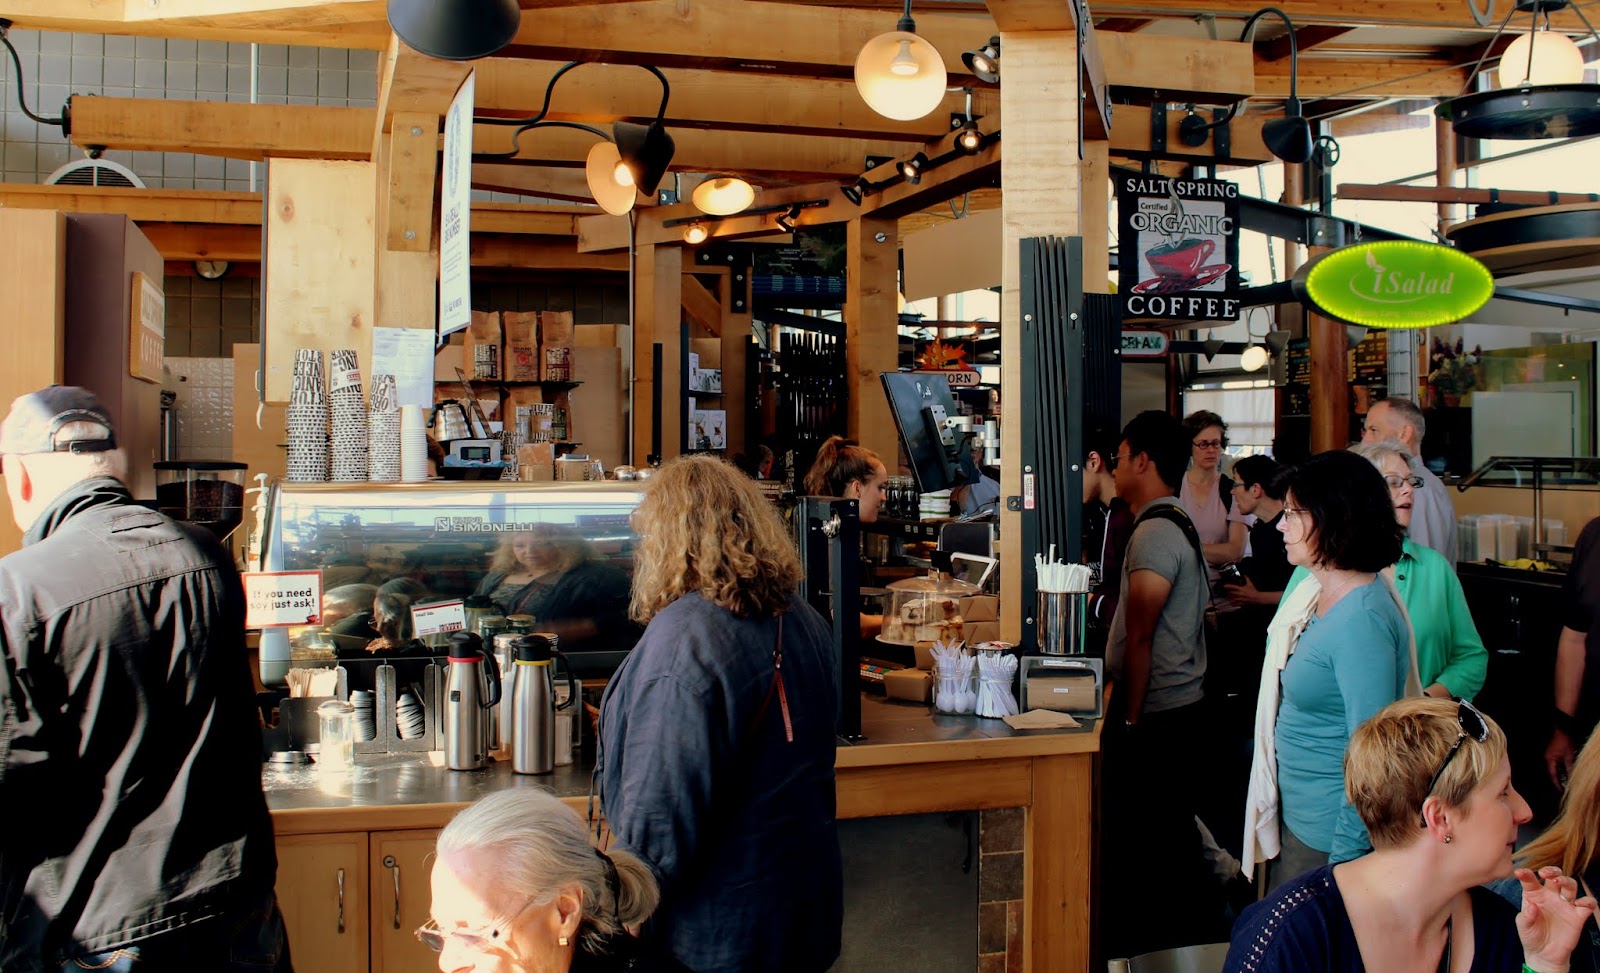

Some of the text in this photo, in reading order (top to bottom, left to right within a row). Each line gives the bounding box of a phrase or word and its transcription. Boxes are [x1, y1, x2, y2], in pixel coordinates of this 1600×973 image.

[1126, 178, 1237, 198] SALT SPRING
[1140, 202, 1168, 211] Certified
[1129, 212, 1234, 236] ORGANIC
[1127, 296, 1236, 318] COFFEE
[453, 523, 533, 532] SIMONELLI
[265, 591, 283, 600] you
[286, 588, 312, 598] need
[271, 599, 291, 611] just
[293, 598, 315, 608] ask!
